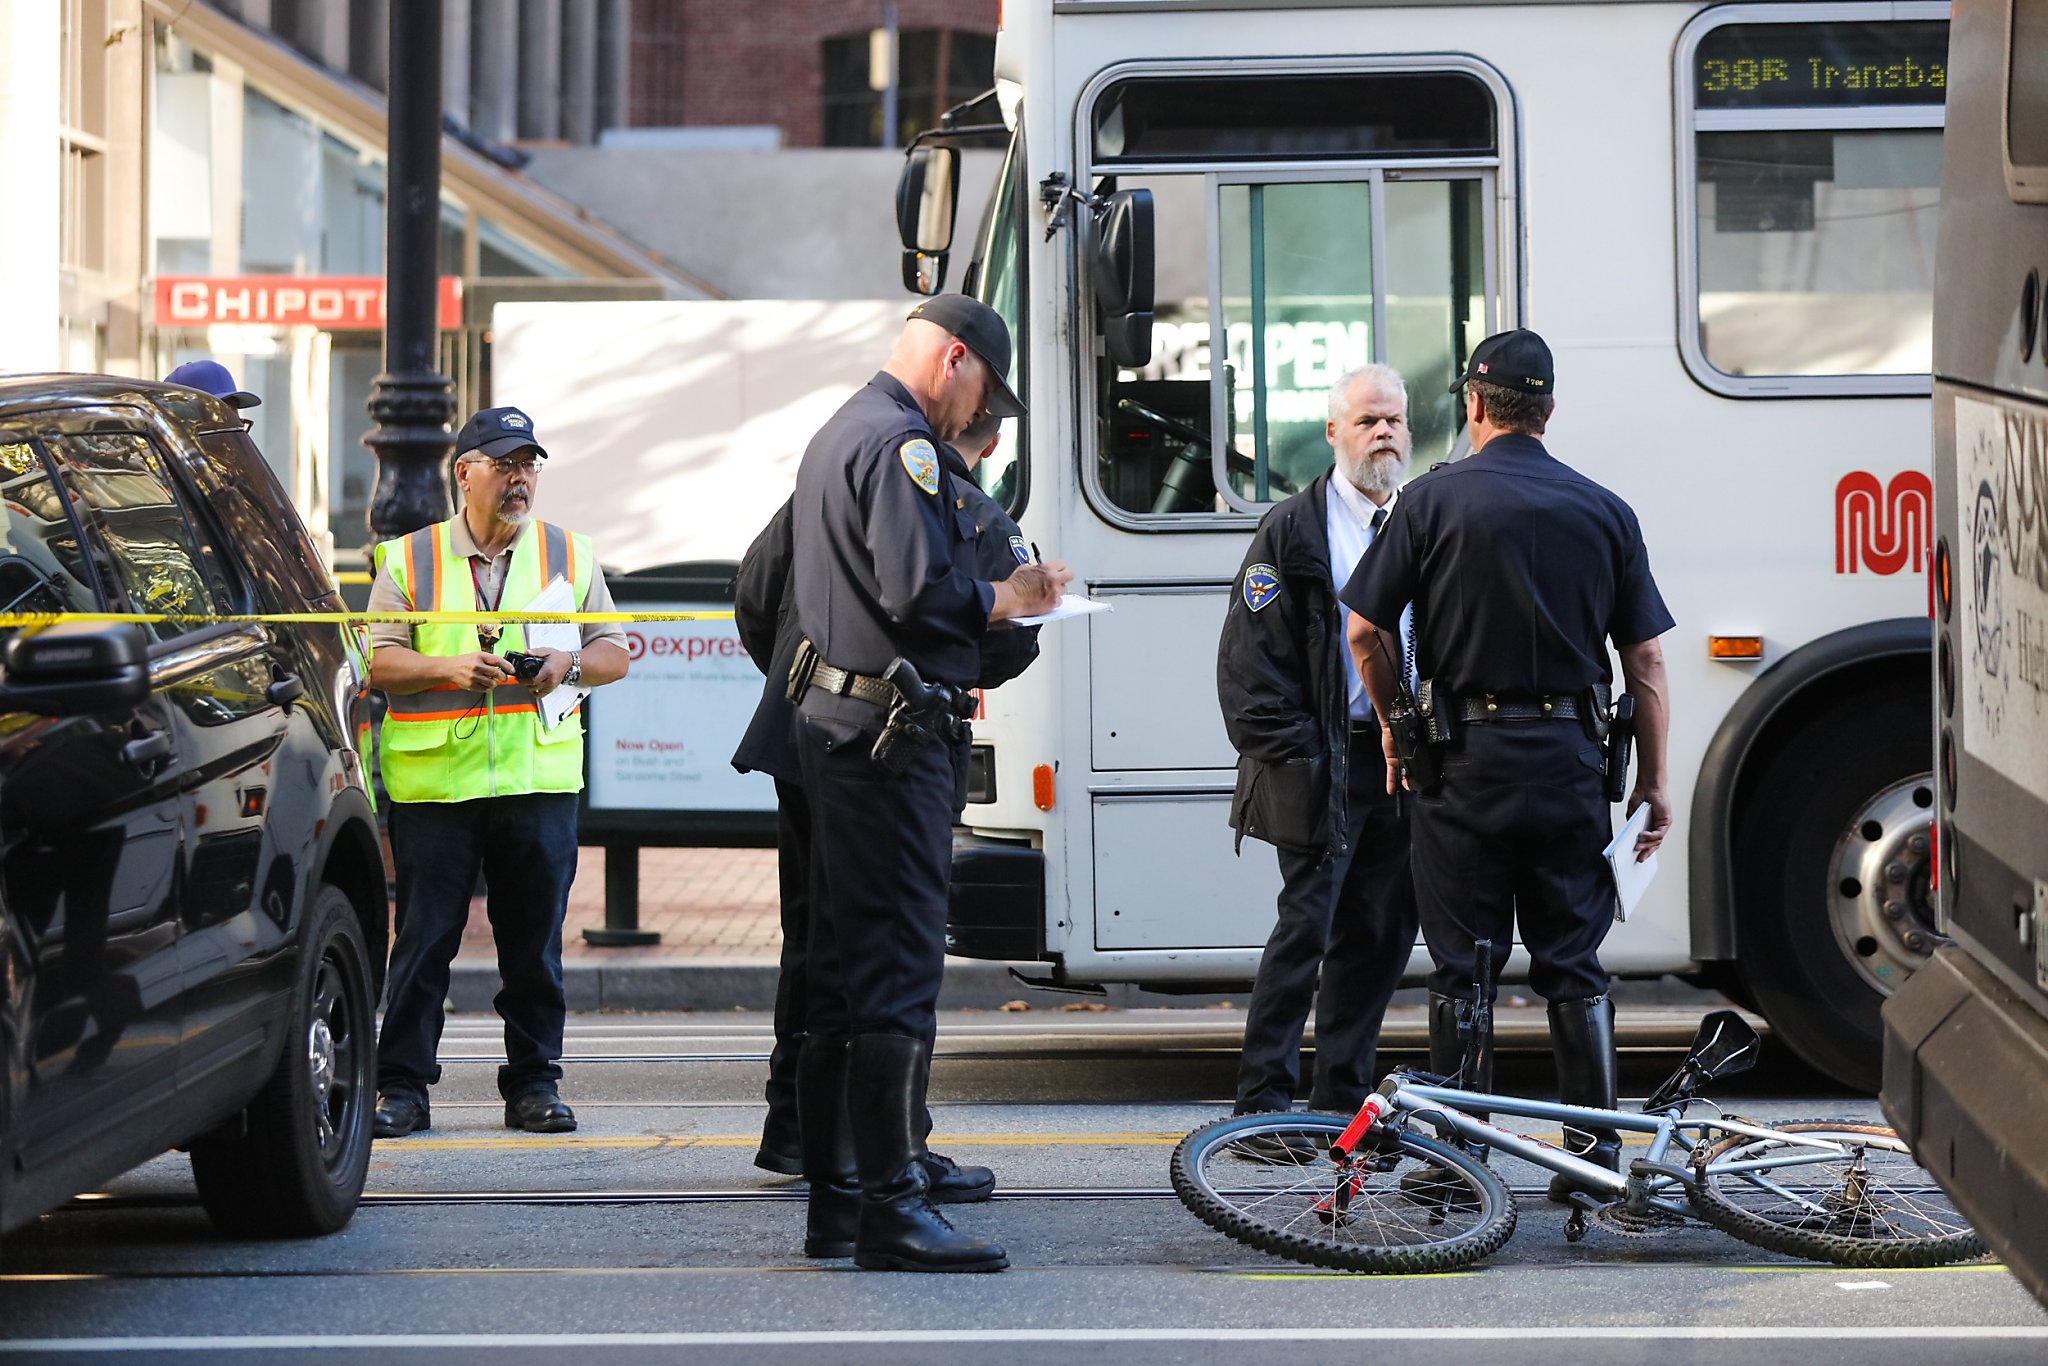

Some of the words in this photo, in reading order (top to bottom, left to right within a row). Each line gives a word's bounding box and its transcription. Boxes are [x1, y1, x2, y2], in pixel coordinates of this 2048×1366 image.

[1703, 58, 1789, 91] 38R
[171, 282, 387, 320] CHIPOT
[615, 739, 645, 751] Now
[649, 739, 684, 753] Open
